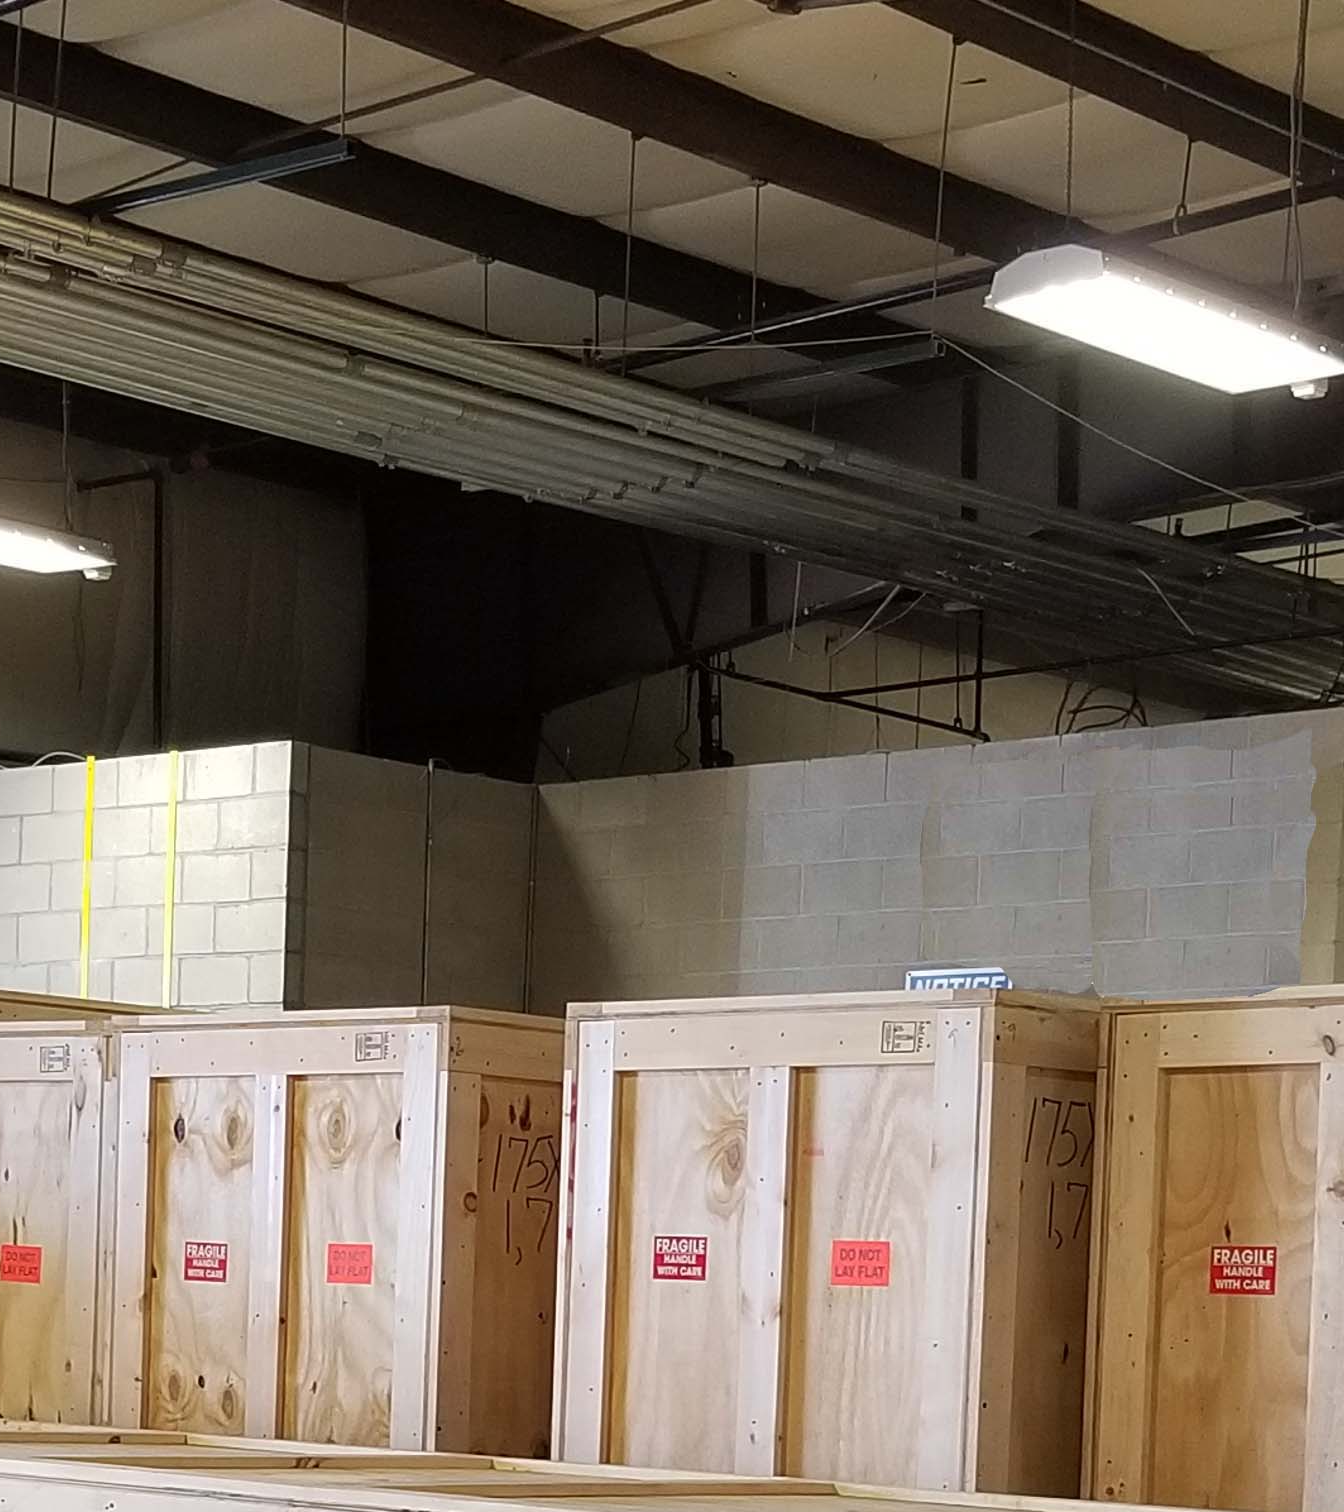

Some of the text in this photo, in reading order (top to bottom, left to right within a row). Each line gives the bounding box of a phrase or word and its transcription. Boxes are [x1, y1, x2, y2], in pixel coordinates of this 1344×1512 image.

[186, 1244, 226, 1259] FRAGILE
[656, 1238, 705, 1254] FRAGILE
[839, 1248, 881, 1262] DO NOT
[1213, 1249, 1275, 1266] FRAGILE
[834, 1265, 885, 1279] LAY FLAT
[1222, 1266, 1263, 1278] HANDLE
[1214, 1278, 1271, 1291] WITH CARE
